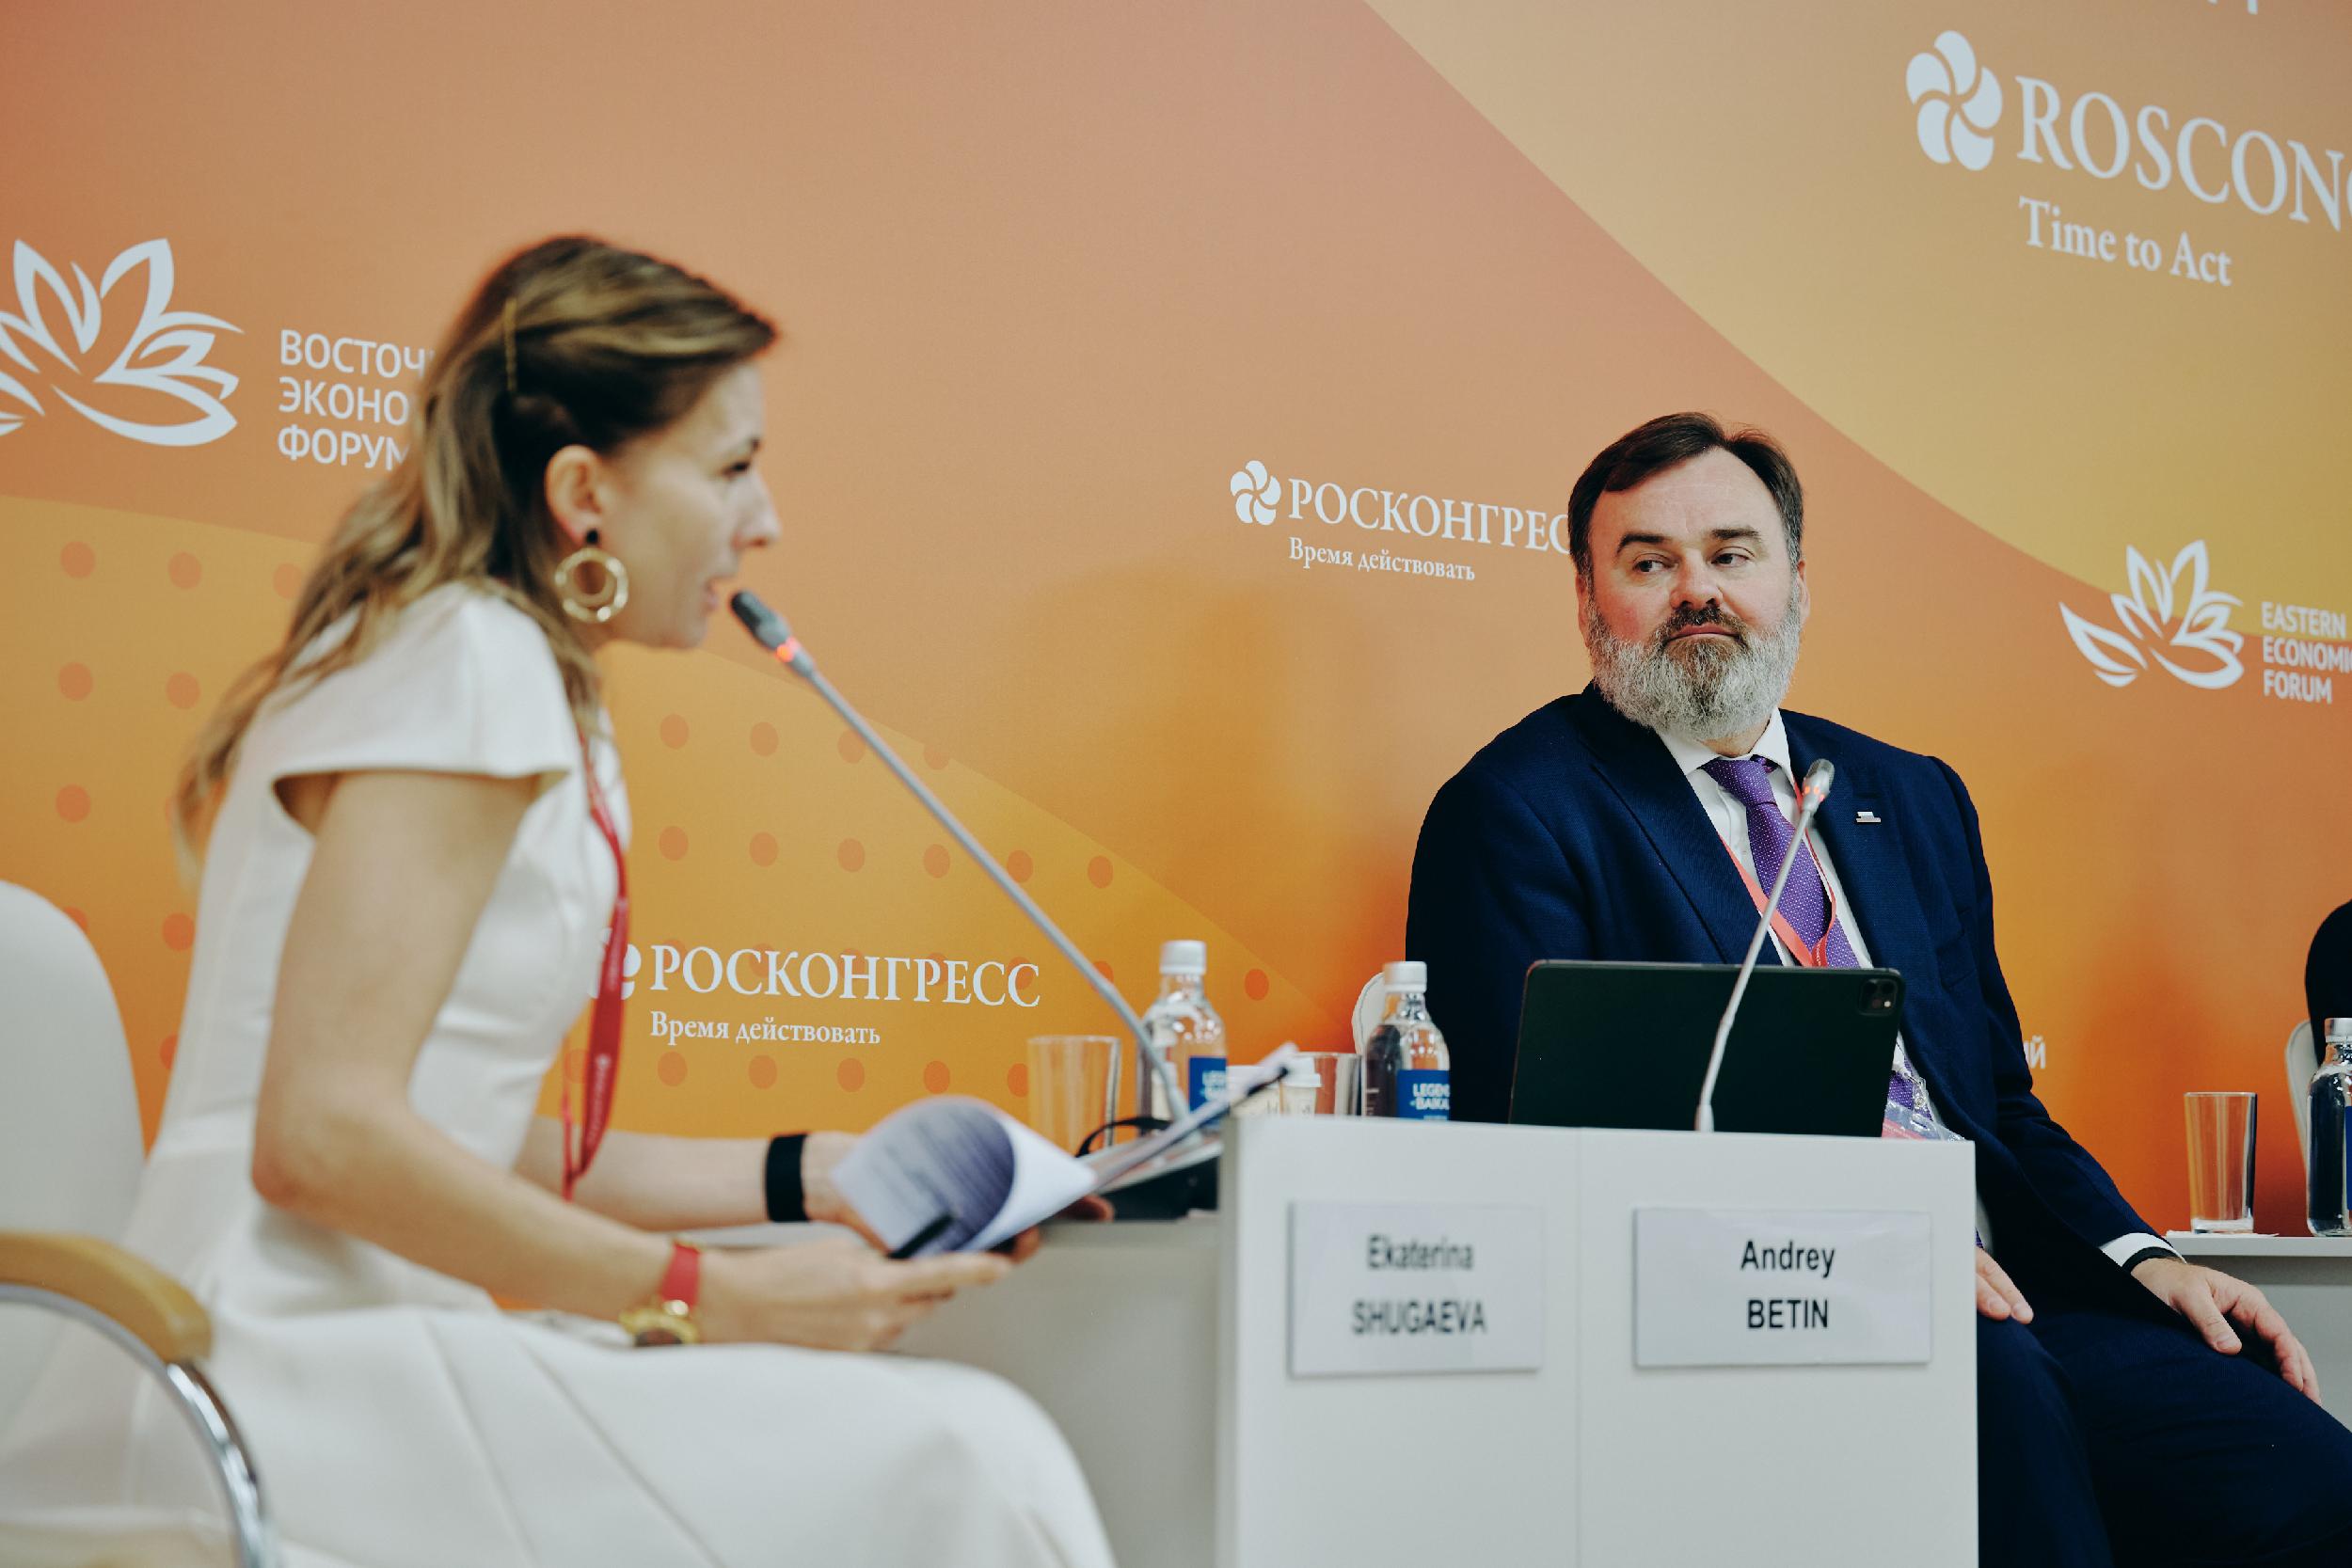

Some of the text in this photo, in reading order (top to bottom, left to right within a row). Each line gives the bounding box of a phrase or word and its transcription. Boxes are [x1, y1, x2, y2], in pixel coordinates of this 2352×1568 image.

[2015, 75, 2352, 232] ROSCON
[2019, 195, 2233, 287] Time to Act
[280, 329, 436, 378] ВОСТОЧ
[278, 376, 417, 426] ЭКОНО
[1289, 536, 1476, 581] Время действовать
[2262, 601, 2346, 640] EASTERN
[2263, 635, 2352, 674] ECONOMI
[2264, 669, 2333, 705] FORUM
[649, 943, 1041, 1007] РОСКОНГРЕСС
[649, 1010, 881, 1046] Время действовать
[1367, 1234, 1474, 1270] Ekaterina
[1740, 1239, 1836, 1279] Andrey
[1352, 1300, 1486, 1335] SHUGAEVA
[1747, 1298, 1829, 1329] BETIN
